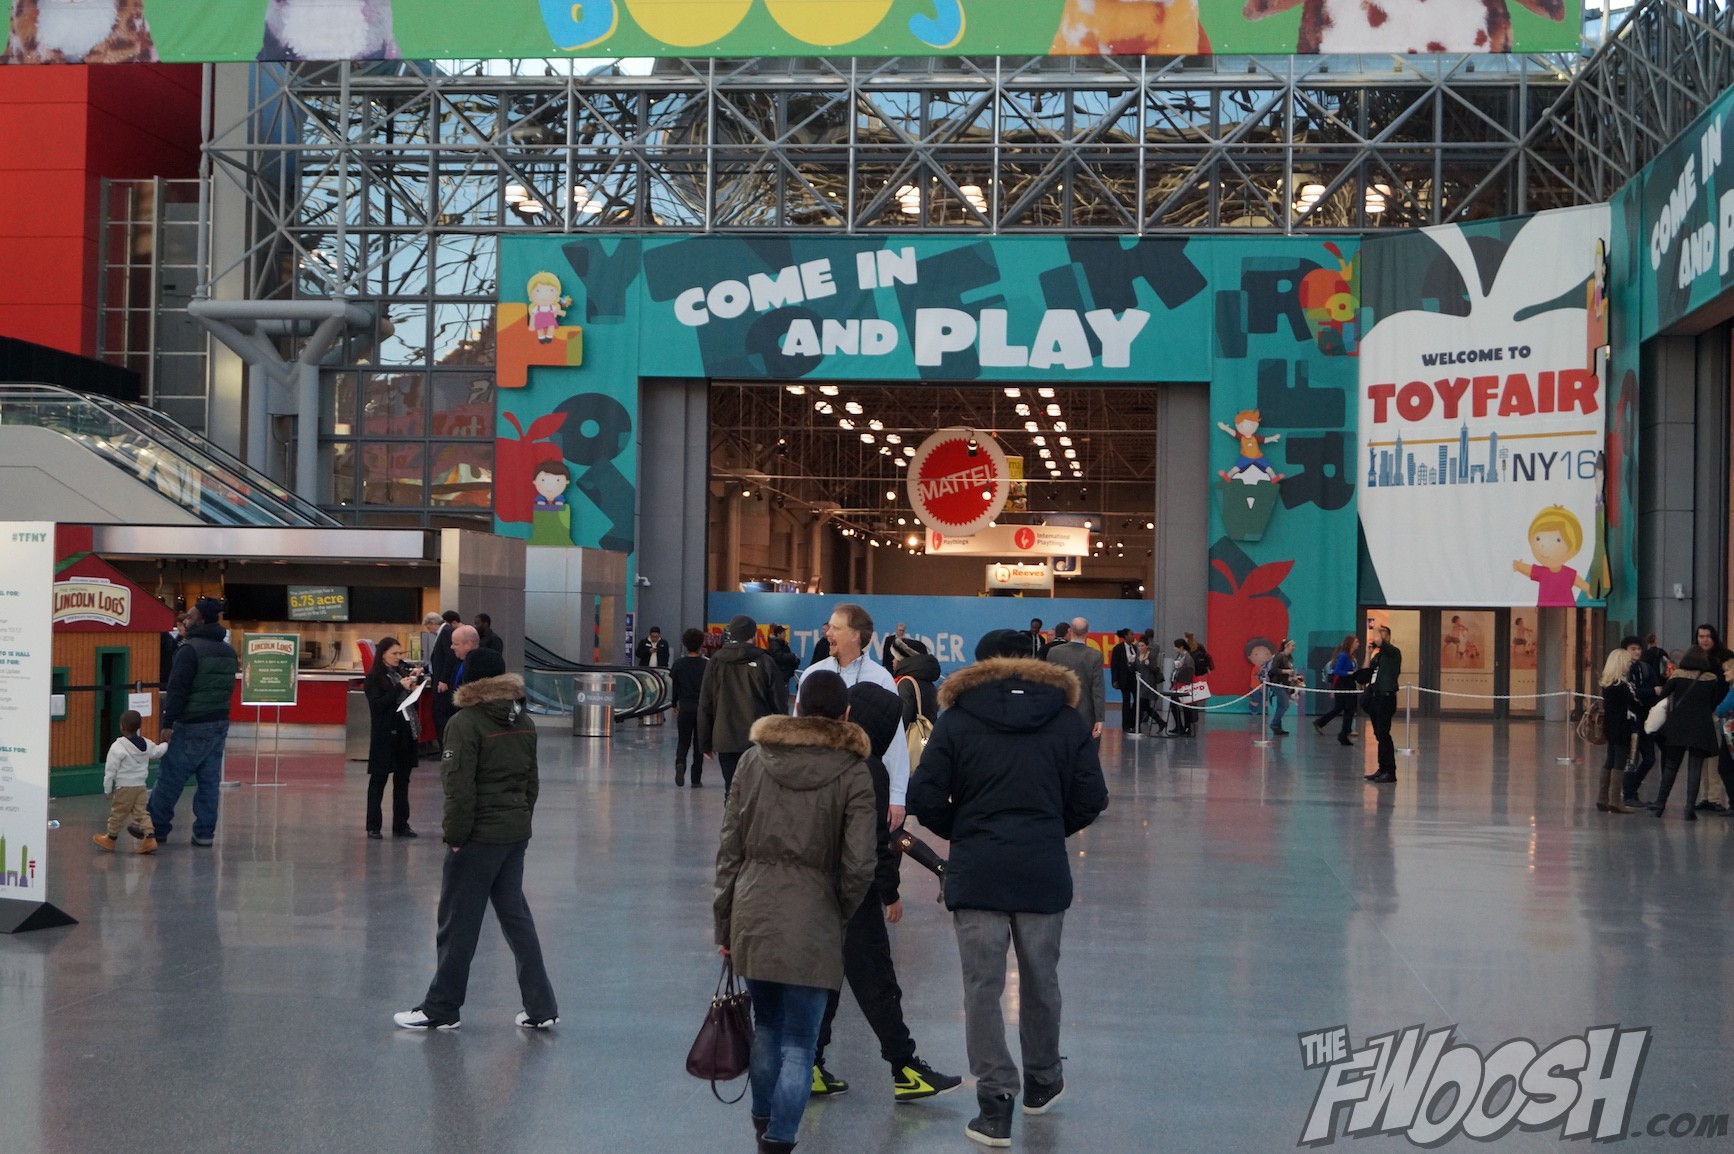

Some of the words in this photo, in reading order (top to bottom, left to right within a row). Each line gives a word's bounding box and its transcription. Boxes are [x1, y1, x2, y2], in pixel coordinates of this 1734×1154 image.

[1650, 153, 1697, 271] COME
[1701, 113, 1722, 185] IN
[1679, 221, 1715, 289] AND
[673, 258, 838, 326] COME
[856, 246, 918, 291] IN
[781, 318, 899, 356] AND
[914, 307, 1151, 370] PLAY
[1421, 347, 1503, 367] WELCOME
[1508, 345, 1532, 360] TO
[1367, 368, 1600, 424] TOYFAIR
[920, 464, 994, 503] MATTEL
[12, 533, 47, 542] #TFNY
[1012, 569, 1045, 577] Reeves
[54, 591, 95, 613] LINCOLN
[98, 591, 125, 616] LOGS
[290, 594, 315, 608] 6.75
[316, 594, 344, 605] acre
[251, 642, 275, 652] LINCOLN
[276, 642, 293, 653] LOGS
[862, 626, 966, 663] WDER
